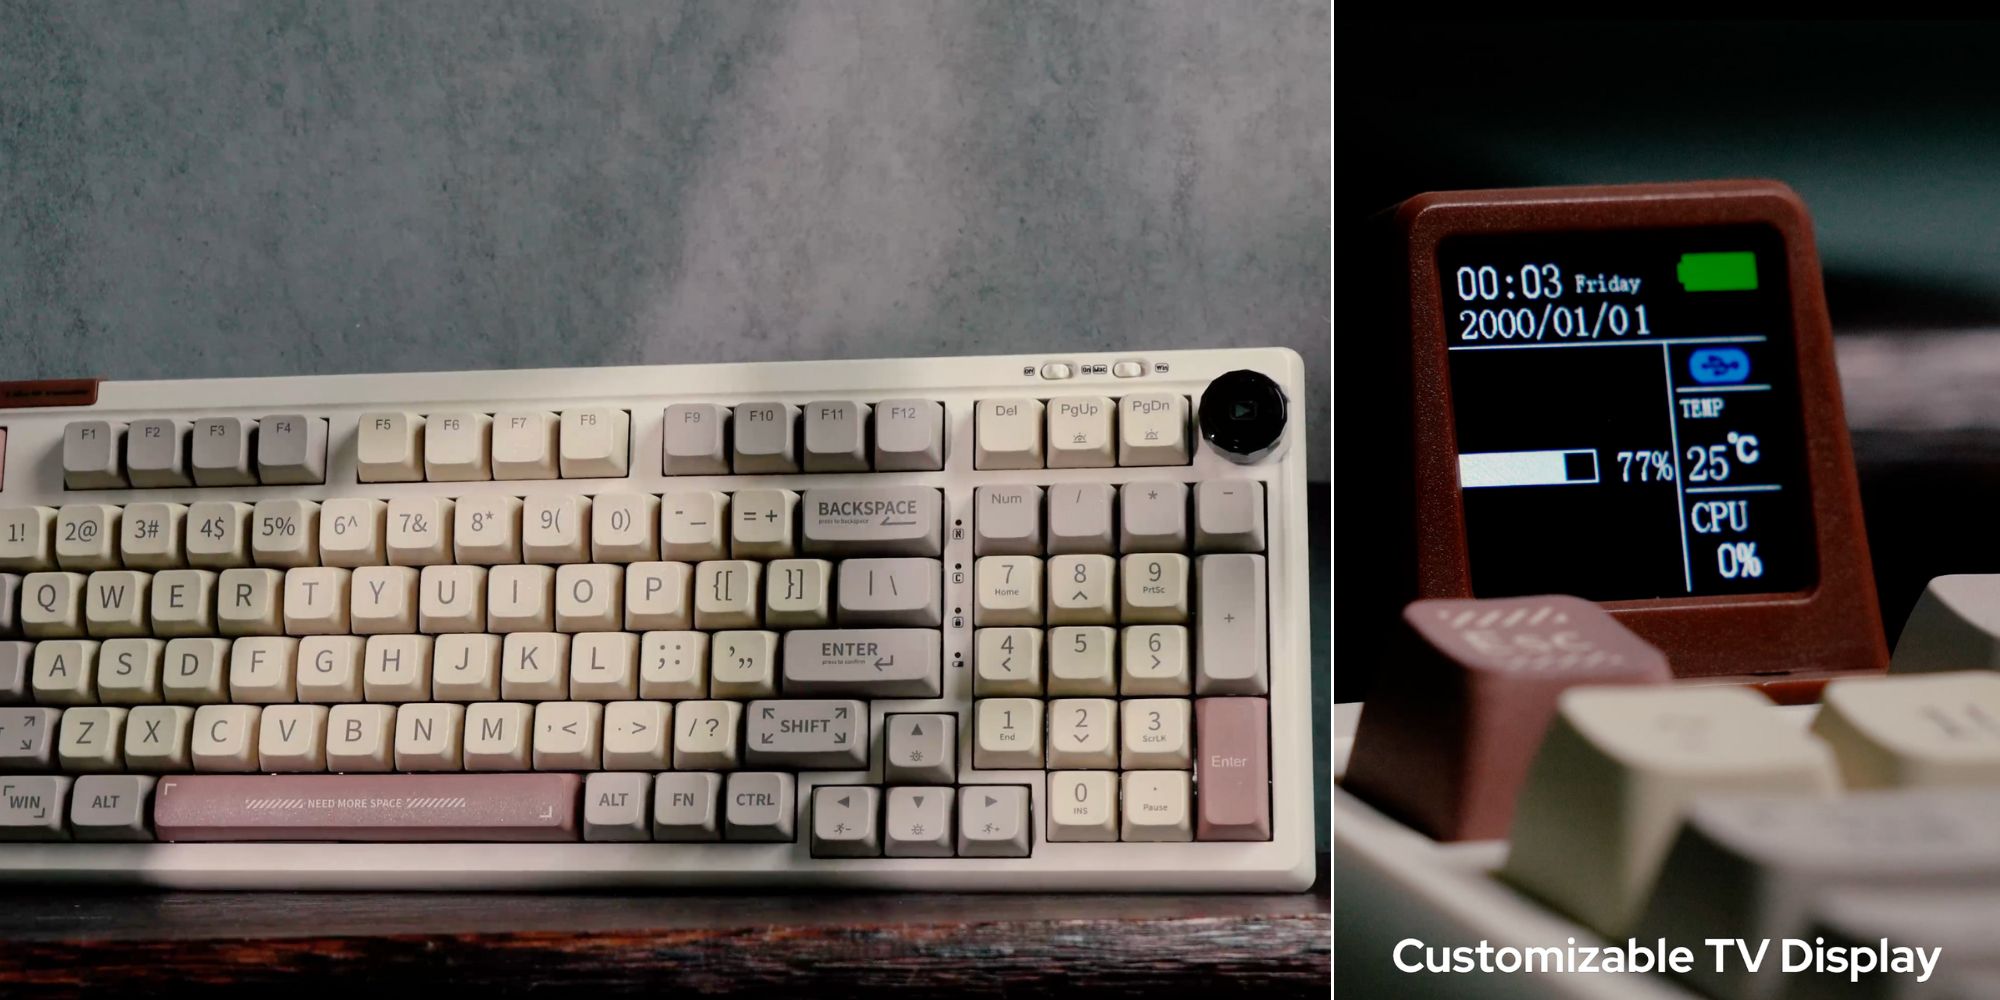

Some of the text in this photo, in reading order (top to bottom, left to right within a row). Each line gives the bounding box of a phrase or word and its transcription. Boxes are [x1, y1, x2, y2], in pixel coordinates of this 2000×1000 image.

[1457, 264, 1642, 301] 00:03 Friday
[1459, 301, 1651, 341] 2000/01/01
[750, 410, 774, 422] F10
[822, 409, 843, 420] F11
[891, 408, 915, 419] F12
[996, 405, 1018, 416] Del
[1061, 404, 1098, 417] PgUp
[1133, 400, 1170, 413] PgDn
[1679, 398, 1724, 418] TEMP
[375, 419, 391, 430] F5
[443, 420, 460, 431] F6
[511, 418, 527, 429] F7
[580, 414, 596, 425] F8
[684, 412, 700, 423] F9
[81, 429, 96, 440] F1
[145, 427, 160, 438] F2
[209, 425, 225, 436] F3
[276, 423, 292, 434] F4
[1616, 450, 1673, 482] 77%
[818, 500, 917, 516] BACKSPACE
[991, 494, 1022, 504] Num
[399, 513, 427, 533] 7&
[541, 509, 561, 533] 9(
[611, 509, 631, 532] 0)
[1690, 500, 1749, 533] CPU
[8, 523, 25, 542] 1!
[65, 520, 98, 542] 2@
[135, 520, 159, 539] 3#
[200, 517, 225, 539] 4$
[262, 517, 295, 536] 5%
[1716, 541, 1763, 578] 0%
[1002, 565, 1014, 584] 7
[1074, 564, 1087, 583] 8
[1149, 562, 1162, 582] 9
[37, 584, 56, 612] Q
[100, 586, 125, 608] W
[170, 584, 184, 608] E
[236, 584, 252, 607] R
[302, 582, 319, 606] T
[369, 581, 385, 605] Y
[438, 580, 456, 604] U
[573, 579, 593, 603] O
[645, 577, 662, 600] P
[994, 588, 1019, 596] Home
[1143, 586, 1165, 594] PrtSc
[822, 643, 878, 656] ENTER
[1000, 635, 1014, 654] 4
[1074, 634, 1087, 653] 5
[1149, 633, 1161, 652] 6
[49, 655, 67, 677] A
[116, 653, 132, 676] S
[181, 654, 199, 676] D
[250, 650, 266, 673] F
[315, 650, 333, 673] G
[381, 649, 401, 672] H
[455, 647, 469, 671] J
[520, 646, 539, 670] K
[591, 647, 605, 670] L
[780, 719, 830, 734] SHIFT
[1003, 711, 1014, 729] 1
[1075, 709, 1088, 728] 2
[1148, 712, 1161, 731] 3
[76, 722, 94, 744] Z
[143, 720, 161, 743] X
[211, 720, 228, 743] C
[279, 719, 296, 742] V
[344, 719, 362, 742] B
[413, 718, 433, 741] N
[481, 718, 503, 741] M
[1000, 733, 1016, 741] End
[1211, 755, 1247, 768] Enter
[10, 796, 40, 808] WIN
[92, 795, 119, 808] ALT
[307, 799, 402, 809] NEED MORE SPACE
[599, 793, 628, 807] ALT
[673, 793, 694, 806] FN
[736, 793, 775, 806] CTRL
[1143, 803, 1168, 812] Pause
[1073, 807, 1088, 815] INS
